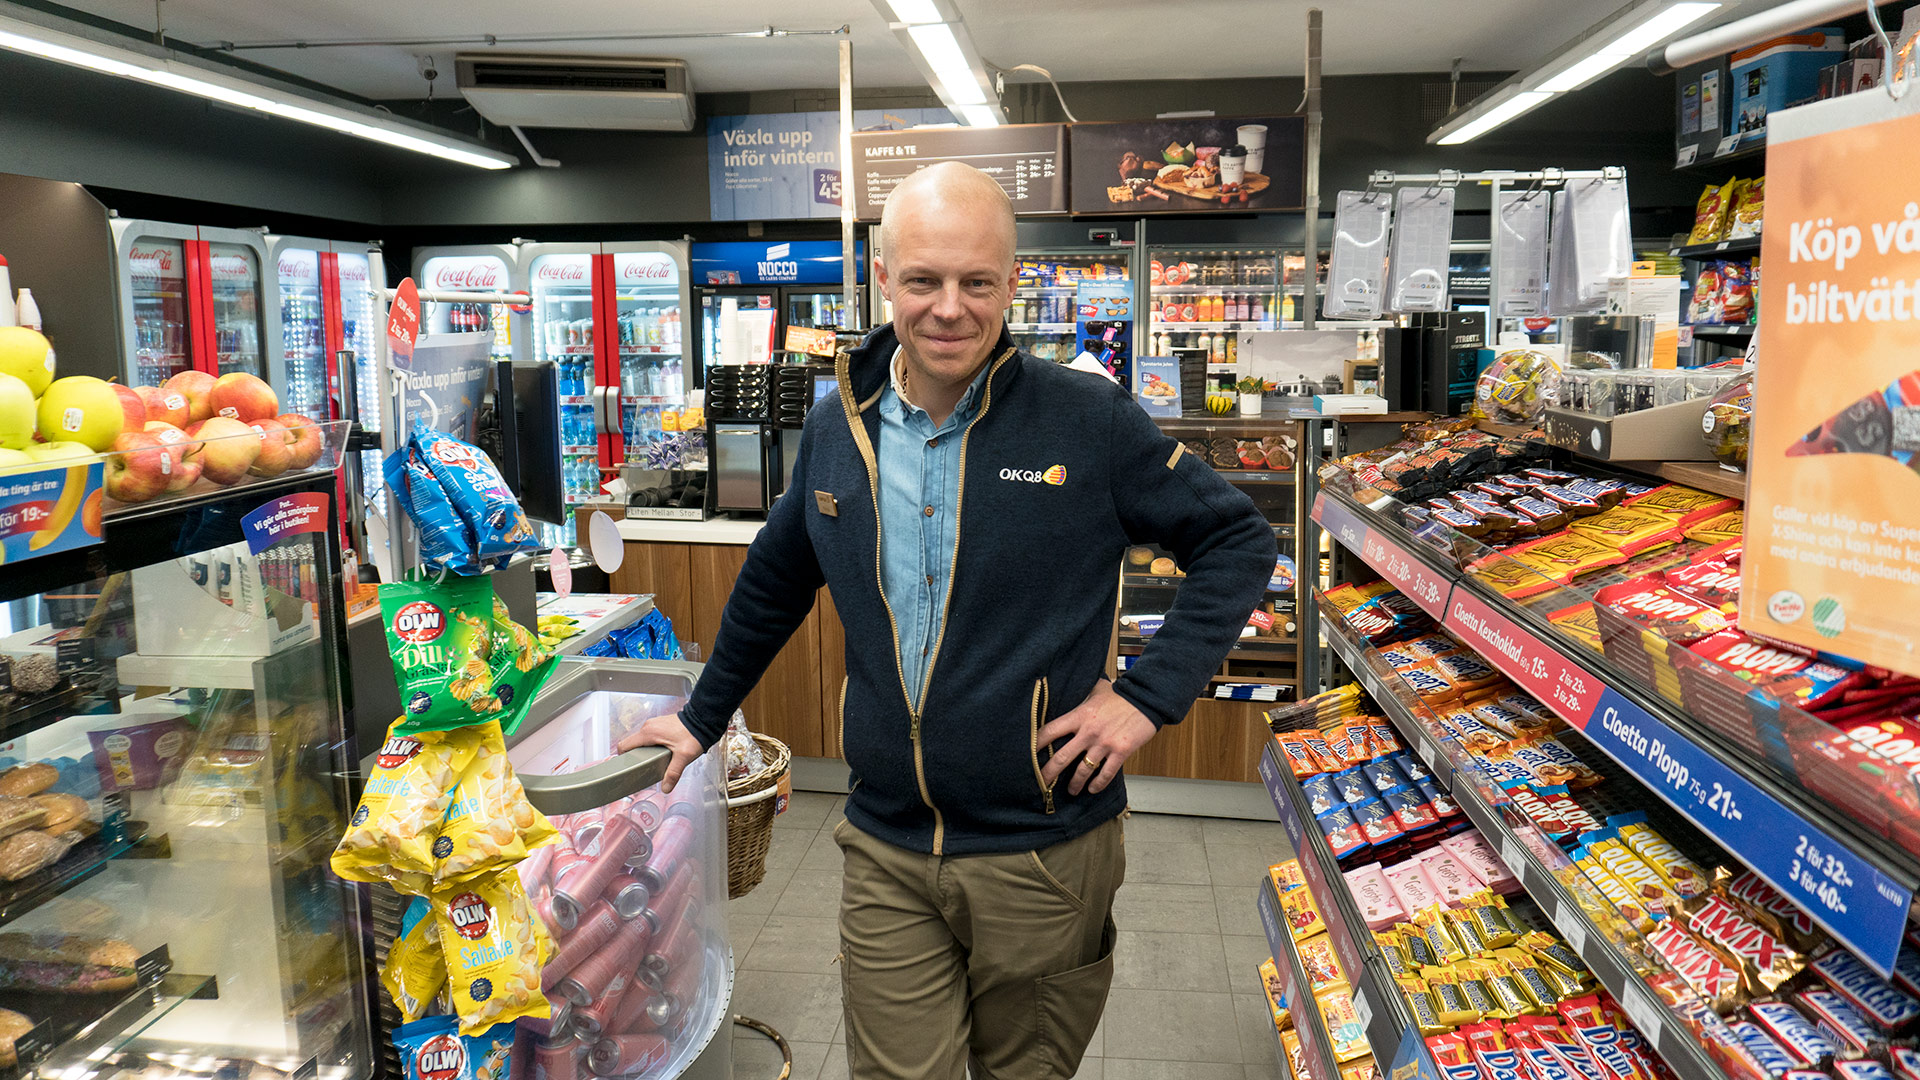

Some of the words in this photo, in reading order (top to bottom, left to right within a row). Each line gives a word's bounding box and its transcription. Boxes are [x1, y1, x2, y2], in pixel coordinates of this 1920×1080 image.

[723, 128, 773, 146] Växla
[779, 131, 812, 148] upp
[724, 150, 766, 166] inför
[771, 149, 834, 165] vintern
[865, 147, 894, 157] KAFFE
[896, 146, 903, 155] &
[904, 145, 917, 155] TE
[820, 174, 826, 182] 2
[826, 174, 837, 182] för
[819, 182, 841, 199] 45
[1789, 217, 1862, 271] Köp
[757, 261, 797, 276] NOCCO
[391, 318, 397, 332] 2
[434, 372, 449, 391] upp
[450, 366, 466, 386] inför
[467, 367, 484, 381] vinter
[999, 468, 1042, 483] OKQ8
[11, 485, 30, 496] ting
[32, 482, 42, 492] är
[44, 481, 57, 490] tre
[21, 506, 49, 522] 19:-
[254, 521, 263, 531] Vi
[263, 515, 275, 529] gör
[274, 510, 287, 522] alla
[288, 504, 320, 516] smörgåsar
[680, 509, 695, 517] Stor
[1772, 505, 1809, 523] Gäller
[1811, 513, 1830, 527] vid
[1832, 514, 1858, 534] köp
[1859, 522, 1878, 535] av
[268, 524, 280, 535] här
[1771, 524, 1817, 545] X-Shine
[1818, 533, 1843, 549] och
[1846, 537, 1871, 553] kan
[1873, 540, 1902, 560] inte
[1386, 554, 1395, 572] 2
[1391, 559, 1400, 576] för
[1770, 545, 1798, 561] med
[1799, 550, 1837, 569] andra
[1413, 573, 1422, 591] 3
[1418, 578, 1428, 598] för
[1425, 582, 1441, 603] 39:-
[1622, 592, 1699, 620] PLOPP
[398, 613, 440, 632] OLW
[1352, 611, 1388, 631] PLOPP
[1453, 602, 1479, 633] Cloetta
[1477, 619, 1524, 664] Kexchoklad
[1531, 656, 1549, 680] 15:-
[402, 645, 444, 669] Dill
[1441, 654, 1492, 681] SPORT
[1716, 642, 1813, 675] PLOPP
[405, 665, 458, 680] Gräslök
[1402, 670, 1451, 692] SPORT
[1559, 668, 1566, 683] 2
[1564, 673, 1573, 688] för
[1571, 677, 1587, 695] 23:-
[1553, 684, 1561, 698] 3
[1559, 690, 1568, 705] för
[1566, 694, 1582, 712] 29:-
[1454, 713, 1488, 735] SPORT
[1485, 704, 1521, 723] SPORT
[381, 739, 419, 756] OLW
[1517, 749, 1555, 768] SPORT
[1541, 742, 1582, 766] SPORT
[1602, 706, 1649, 757] Cloetta
[1648, 738, 1689, 791] Plopp
[1707, 782, 1743, 821] 21:-
[448, 798, 480, 821] tade
[1513, 792, 1558, 824] PLOPP
[1552, 798, 1602, 832] PLOPP
[1470, 846, 1499, 866] Geisha
[1634, 832, 1694, 869] PLOPP
[1795, 835, 1808, 858] 2
[1806, 845, 1825, 871] för
[1823, 854, 1854, 888] 32:-
[1438, 865, 1462, 885] Geisha
[1603, 847, 1662, 888] PLOPP
[1362, 883, 1382, 904] Geisha
[1404, 880, 1426, 904] Geisha
[1789, 859, 1801, 882] 3
[1800, 870, 1818, 895] för
[1816, 881, 1848, 915] 40:-
[452, 903, 487, 928] OLW
[1689, 894, 1790, 973] TWIX
[1646, 921, 1740, 1000] TWIX
[1523, 967, 1554, 1004] NOUGAT
[1817, 952, 1908, 1020] SNICKERS
[1413, 992, 1436, 1026] NOUGAT
[421, 1049, 460, 1075] OLW
[1581, 1024, 1634, 1077] Daim
